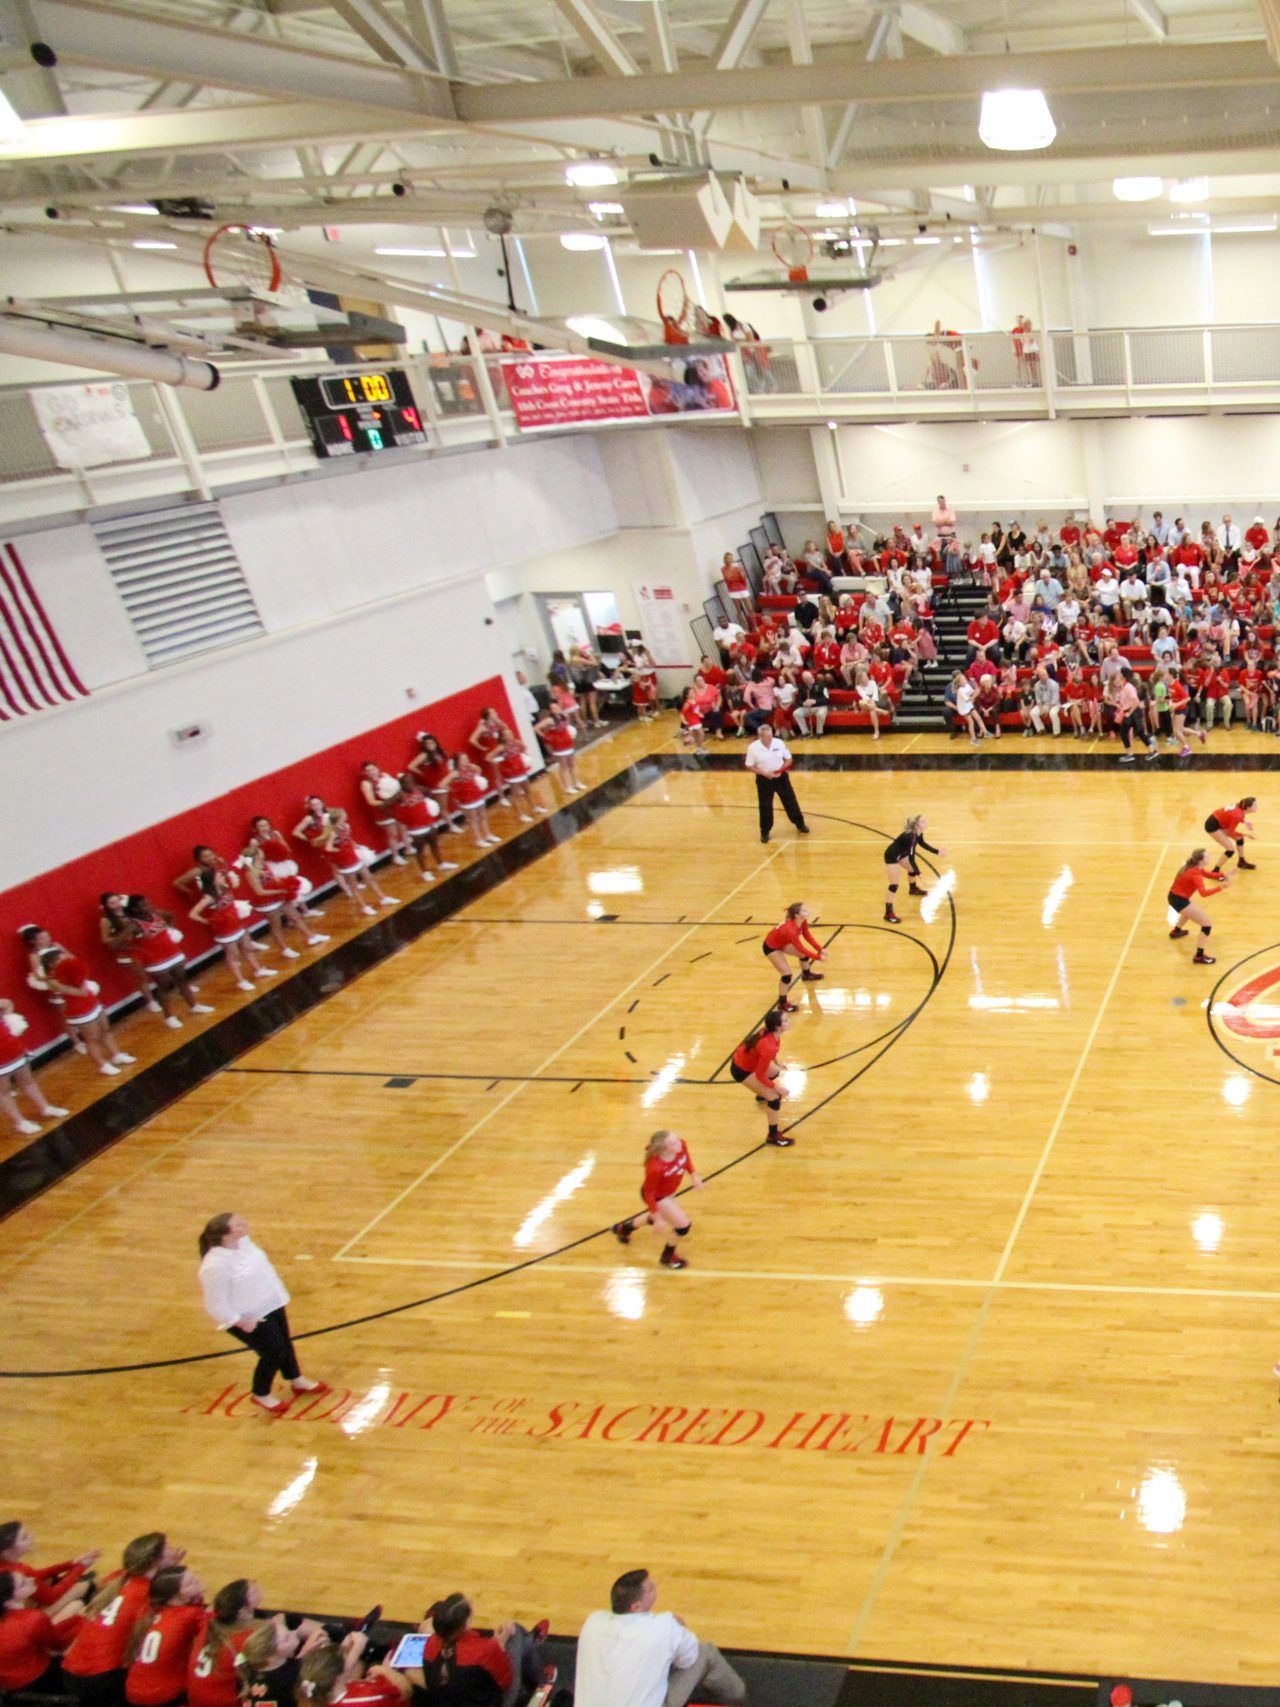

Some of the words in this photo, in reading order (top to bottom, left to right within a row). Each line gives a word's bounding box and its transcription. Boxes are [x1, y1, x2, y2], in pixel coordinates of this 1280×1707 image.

[343, 375, 391, 403] 1:00
[527, 1400, 767, 1447] SACRED
[766, 1411, 992, 1458] HEART
